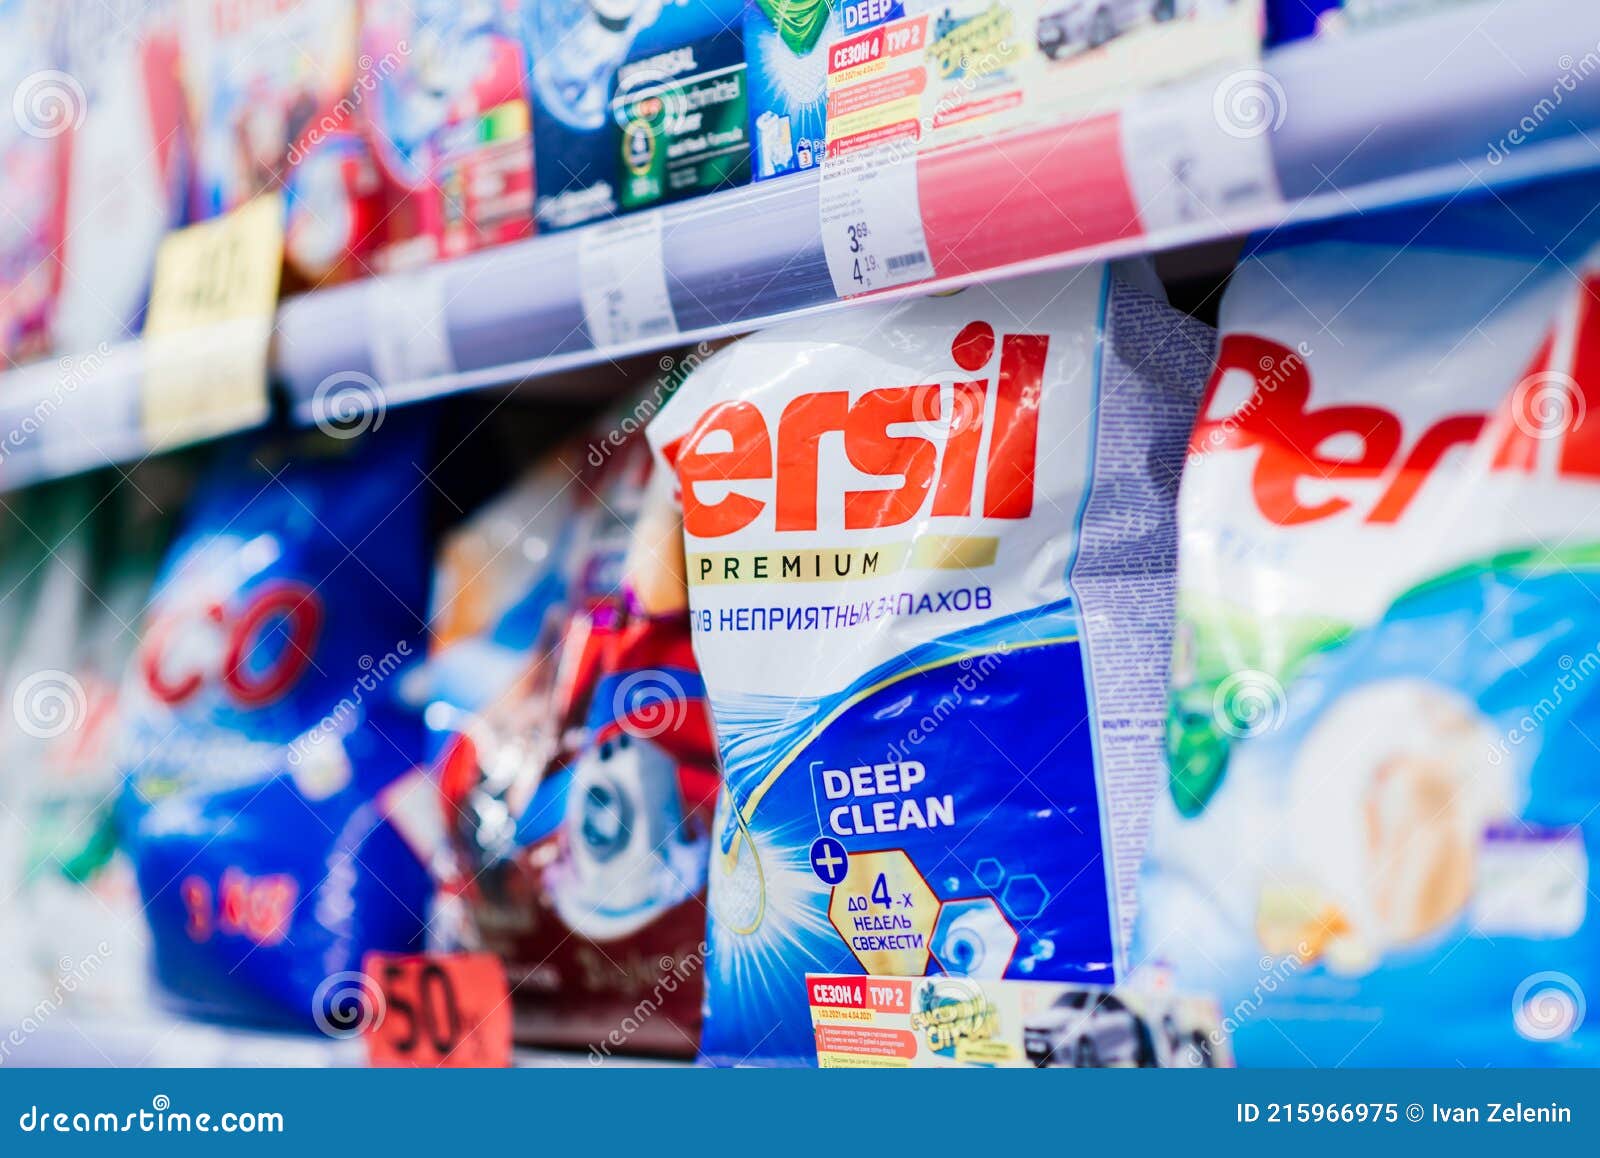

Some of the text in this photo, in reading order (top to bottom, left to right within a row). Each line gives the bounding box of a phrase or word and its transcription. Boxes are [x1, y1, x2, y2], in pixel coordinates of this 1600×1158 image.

[845, 0, 892, 29] DEEP
[833, 25, 920, 69] СЕЗОН 4 ТУР 2
[847, 221, 869, 253] 3 69
[853, 254, 877, 285] 4 19
[662, 320, 1050, 538] ersil
[700, 552, 879, 580] PREMIUM
[720, 600, 873, 631] НЕПРИЯТНЫХ
[875, 587, 992, 619] ЗАПАХОВ
[822, 760, 926, 800] DEEP
[829, 794, 955, 836] CLEAN
[847, 895, 868, 912] ДО
[853, 914, 912, 932] НЕДЕЛЬ
[852, 933, 924, 952] СВЕЖЕСТИ
[813, 983, 905, 1008] СЕЗОН 4 ТУР 2
